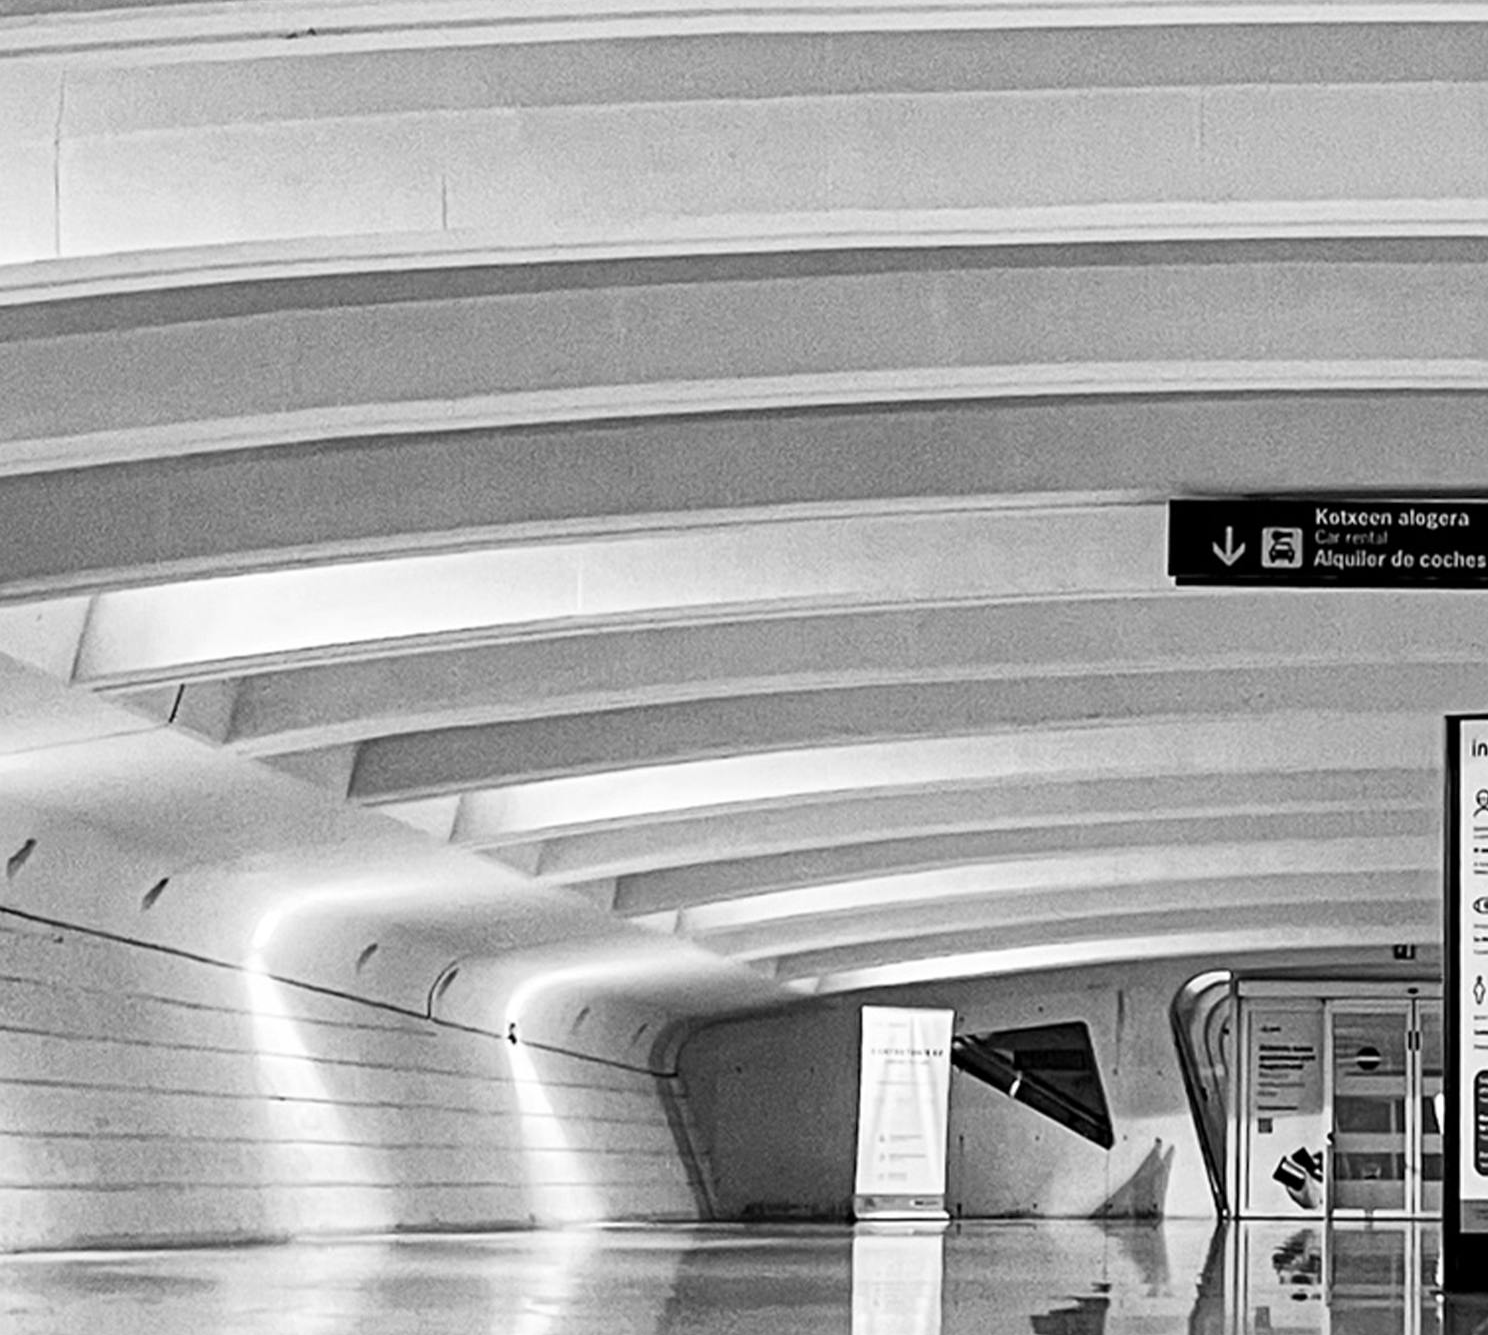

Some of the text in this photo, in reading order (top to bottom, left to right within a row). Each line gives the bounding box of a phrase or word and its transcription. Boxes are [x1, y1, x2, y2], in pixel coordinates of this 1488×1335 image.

[1315, 508, 1469, 529] Kotxeen alogera
[1314, 528, 1388, 545] Car rental
[1314, 549, 1486, 570] Alquiler de coches
